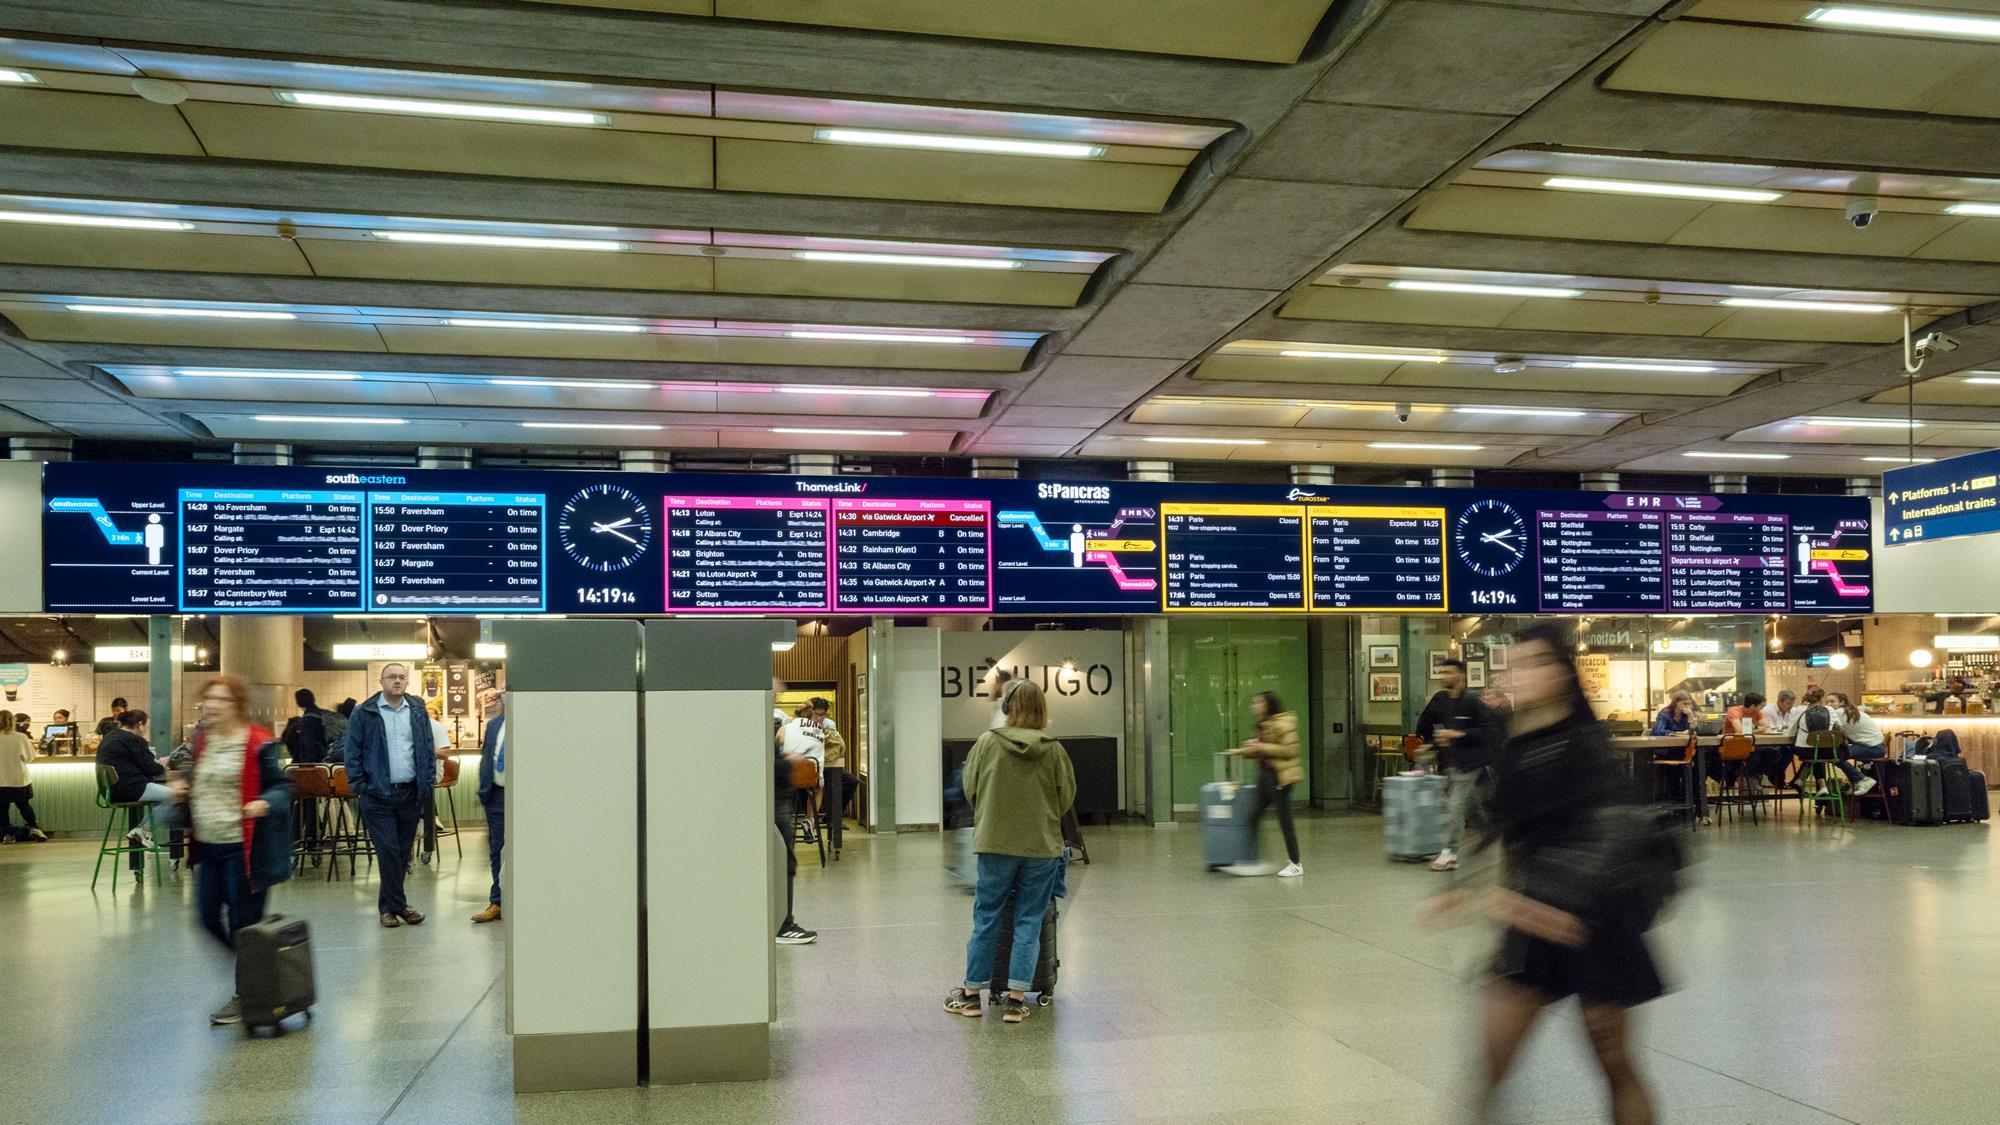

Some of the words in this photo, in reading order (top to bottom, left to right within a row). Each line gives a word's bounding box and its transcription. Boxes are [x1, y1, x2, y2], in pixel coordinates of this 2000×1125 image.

[326, 474, 406, 485] southeastern
[1902, 486, 1949, 501] Platforms
[1951, 481, 1969, 493] 1-4
[187, 503, 207, 511] 14:20
[226, 504, 266, 512] Faversham
[374, 507, 395, 515] 15:50
[507, 508, 518, 516] On
[520, 508, 537, 516] time
[1902, 501, 1963, 520] International
[1965, 498, 1996, 510] trains
[672, 509, 690, 517] 14:13
[789, 511, 804, 519] Expt
[903, 514, 926, 522] Airport
[1390, 520, 1417, 528] Expected
[214, 525, 244, 534] Margate
[319, 526, 335, 534] Expt
[337, 526, 356, 534] 14:42
[374, 524, 395, 532] 16:07
[425, 525, 448, 534] Priory
[838, 529, 856, 537] 14:31
[862, 530, 900, 538] Cambridge
[728, 530, 741, 539] City
[789, 531, 804, 539] Expt
[696, 551, 724, 559] Brighton
[1671, 557, 1705, 565] Departures
[1713, 557, 1732, 565] airport
[1268, 573, 1286, 581] Opens
[226, 590, 266, 598] Canterbury
[577, 588, 621, 603] 14:19
[622, 592, 635, 603] 14
[1471, 591, 1505, 604] 14:19
[1506, 594, 1516, 604] 14
[897, 596, 920, 604] Airport
[941, 664, 1113, 698] BEUGO
